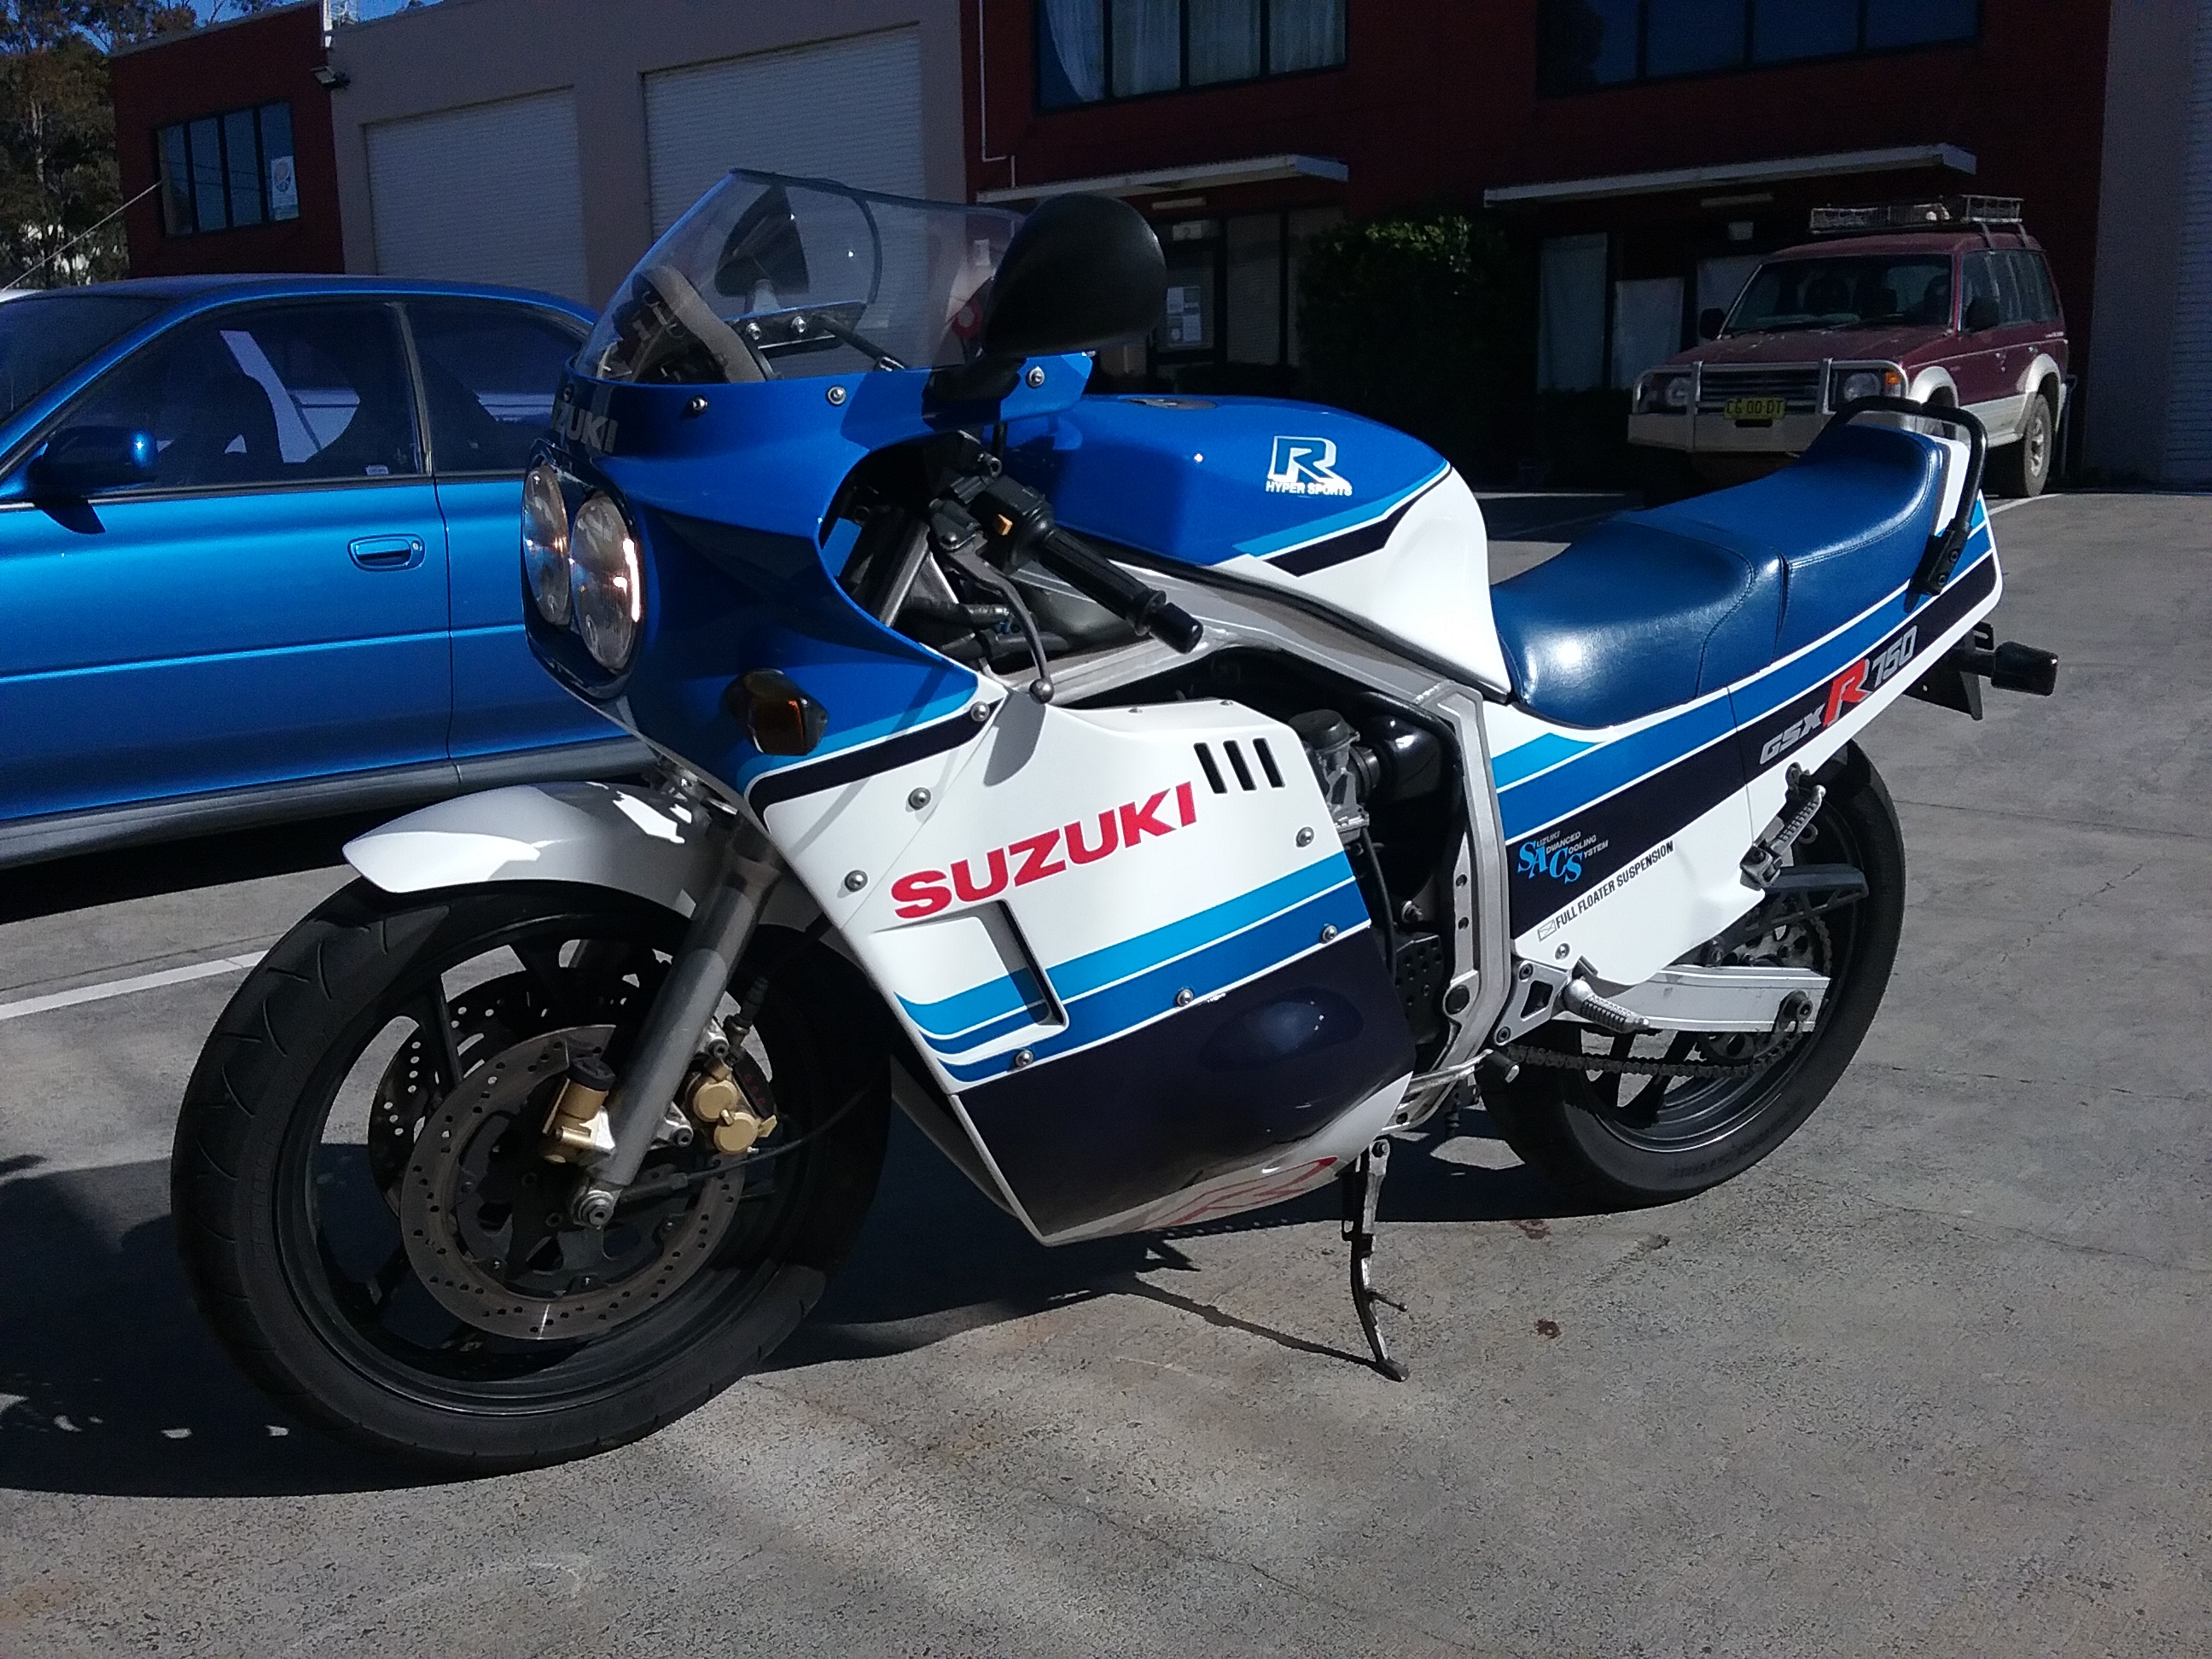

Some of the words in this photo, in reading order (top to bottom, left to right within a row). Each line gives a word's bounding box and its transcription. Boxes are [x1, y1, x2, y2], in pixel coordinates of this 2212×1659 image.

[1266, 480, 1306, 494] HYPER
[1307, 482, 1353, 497] SPORTS
[1267, 435, 1351, 486] R
[1871, 625, 1918, 689] 750
[890, 781, 1198, 920] SUZUKI
[1554, 905, 1578, 929] FULL
[1577, 880, 1615, 915] FLOATER
[1616, 840, 1674, 888] SUSPENSION
